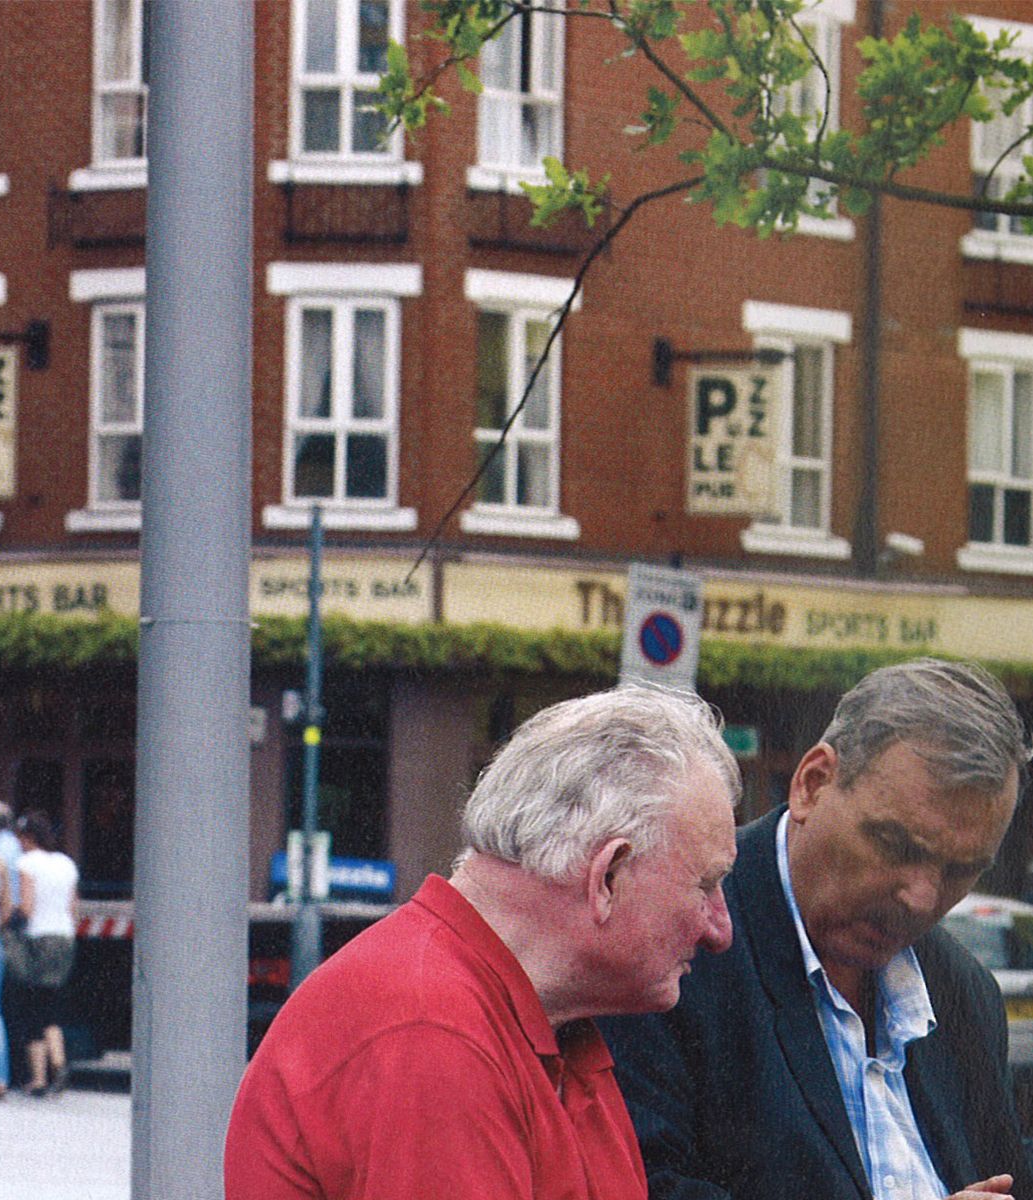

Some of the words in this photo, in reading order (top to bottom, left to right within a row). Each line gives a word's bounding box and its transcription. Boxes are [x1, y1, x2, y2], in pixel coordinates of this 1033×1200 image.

[54, 582, 108, 612] BAR
[261, 577, 360, 597] SPOTS
[371, 578, 421, 598] BAR
[576, 580, 625, 626] Th
